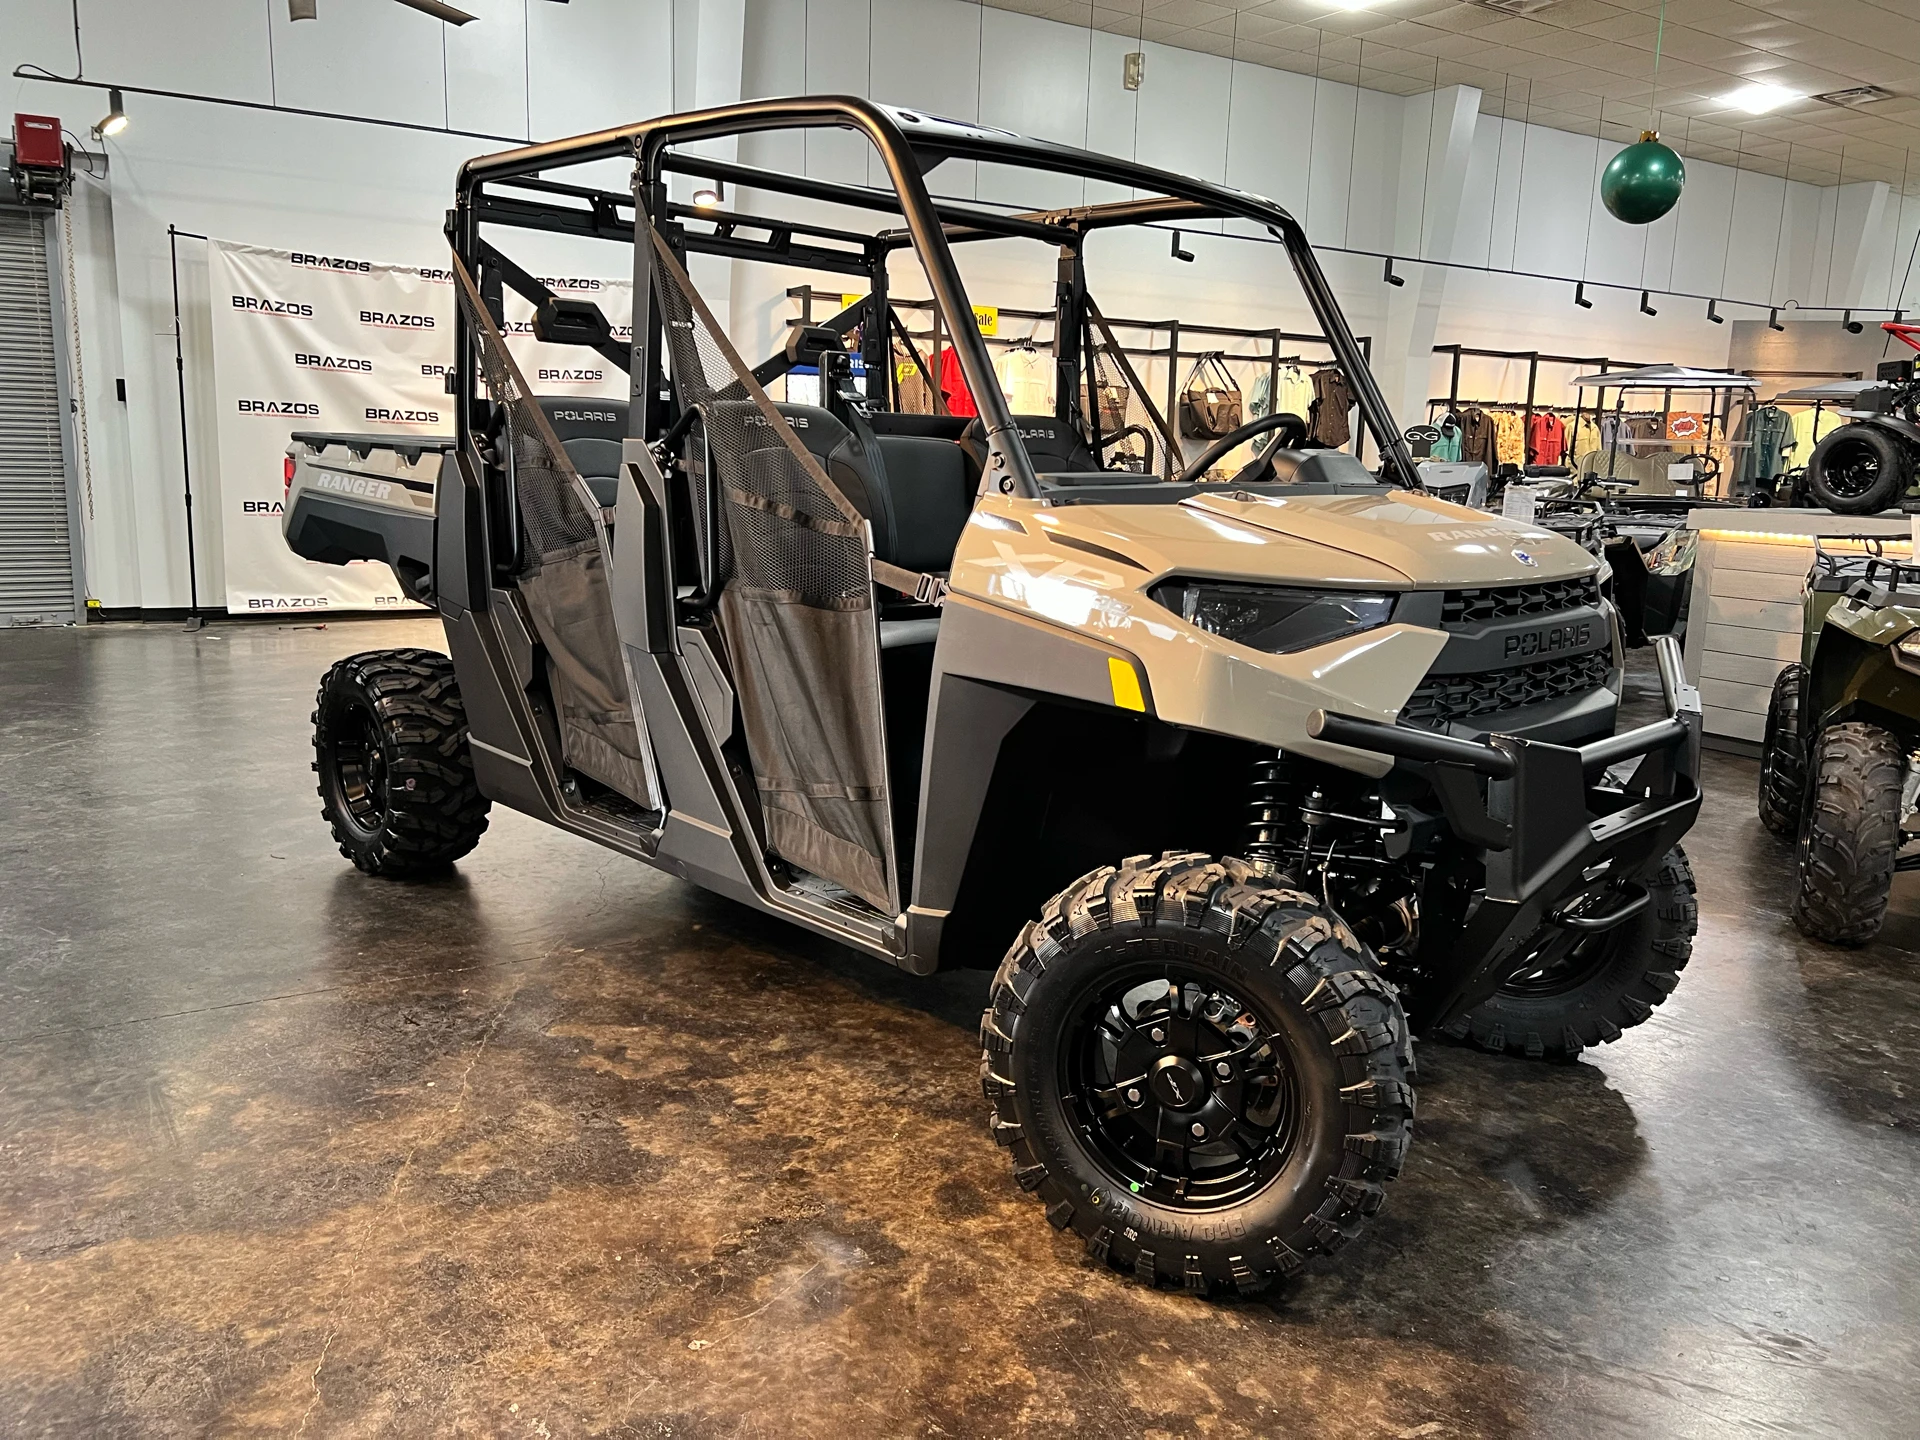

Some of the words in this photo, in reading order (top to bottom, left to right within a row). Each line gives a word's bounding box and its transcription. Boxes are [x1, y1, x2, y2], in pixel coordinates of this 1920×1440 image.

[291, 252, 370, 272] BRAZOS
[420, 269, 454, 280] BRA
[232, 295, 313, 316] BRAZOS
[360, 310, 435, 327] BRAZOS
[295, 353, 372, 371] BRAZOS
[421, 364, 456, 375] BRA
[538, 369, 603, 380] BRAZOS
[238, 399, 320, 415] BRAZOS
[365, 407, 439, 422] BRAZOS
[554, 410, 617, 422] POLARIS
[1018, 429, 1055, 439] OLARIS
[317, 473, 392, 500] RANGER
[243, 501, 285, 513] BRA
[248, 597, 328, 609] BRAZOS
[375, 596, 416, 605] BRA
[1504, 622, 1590, 661] POLARIS
